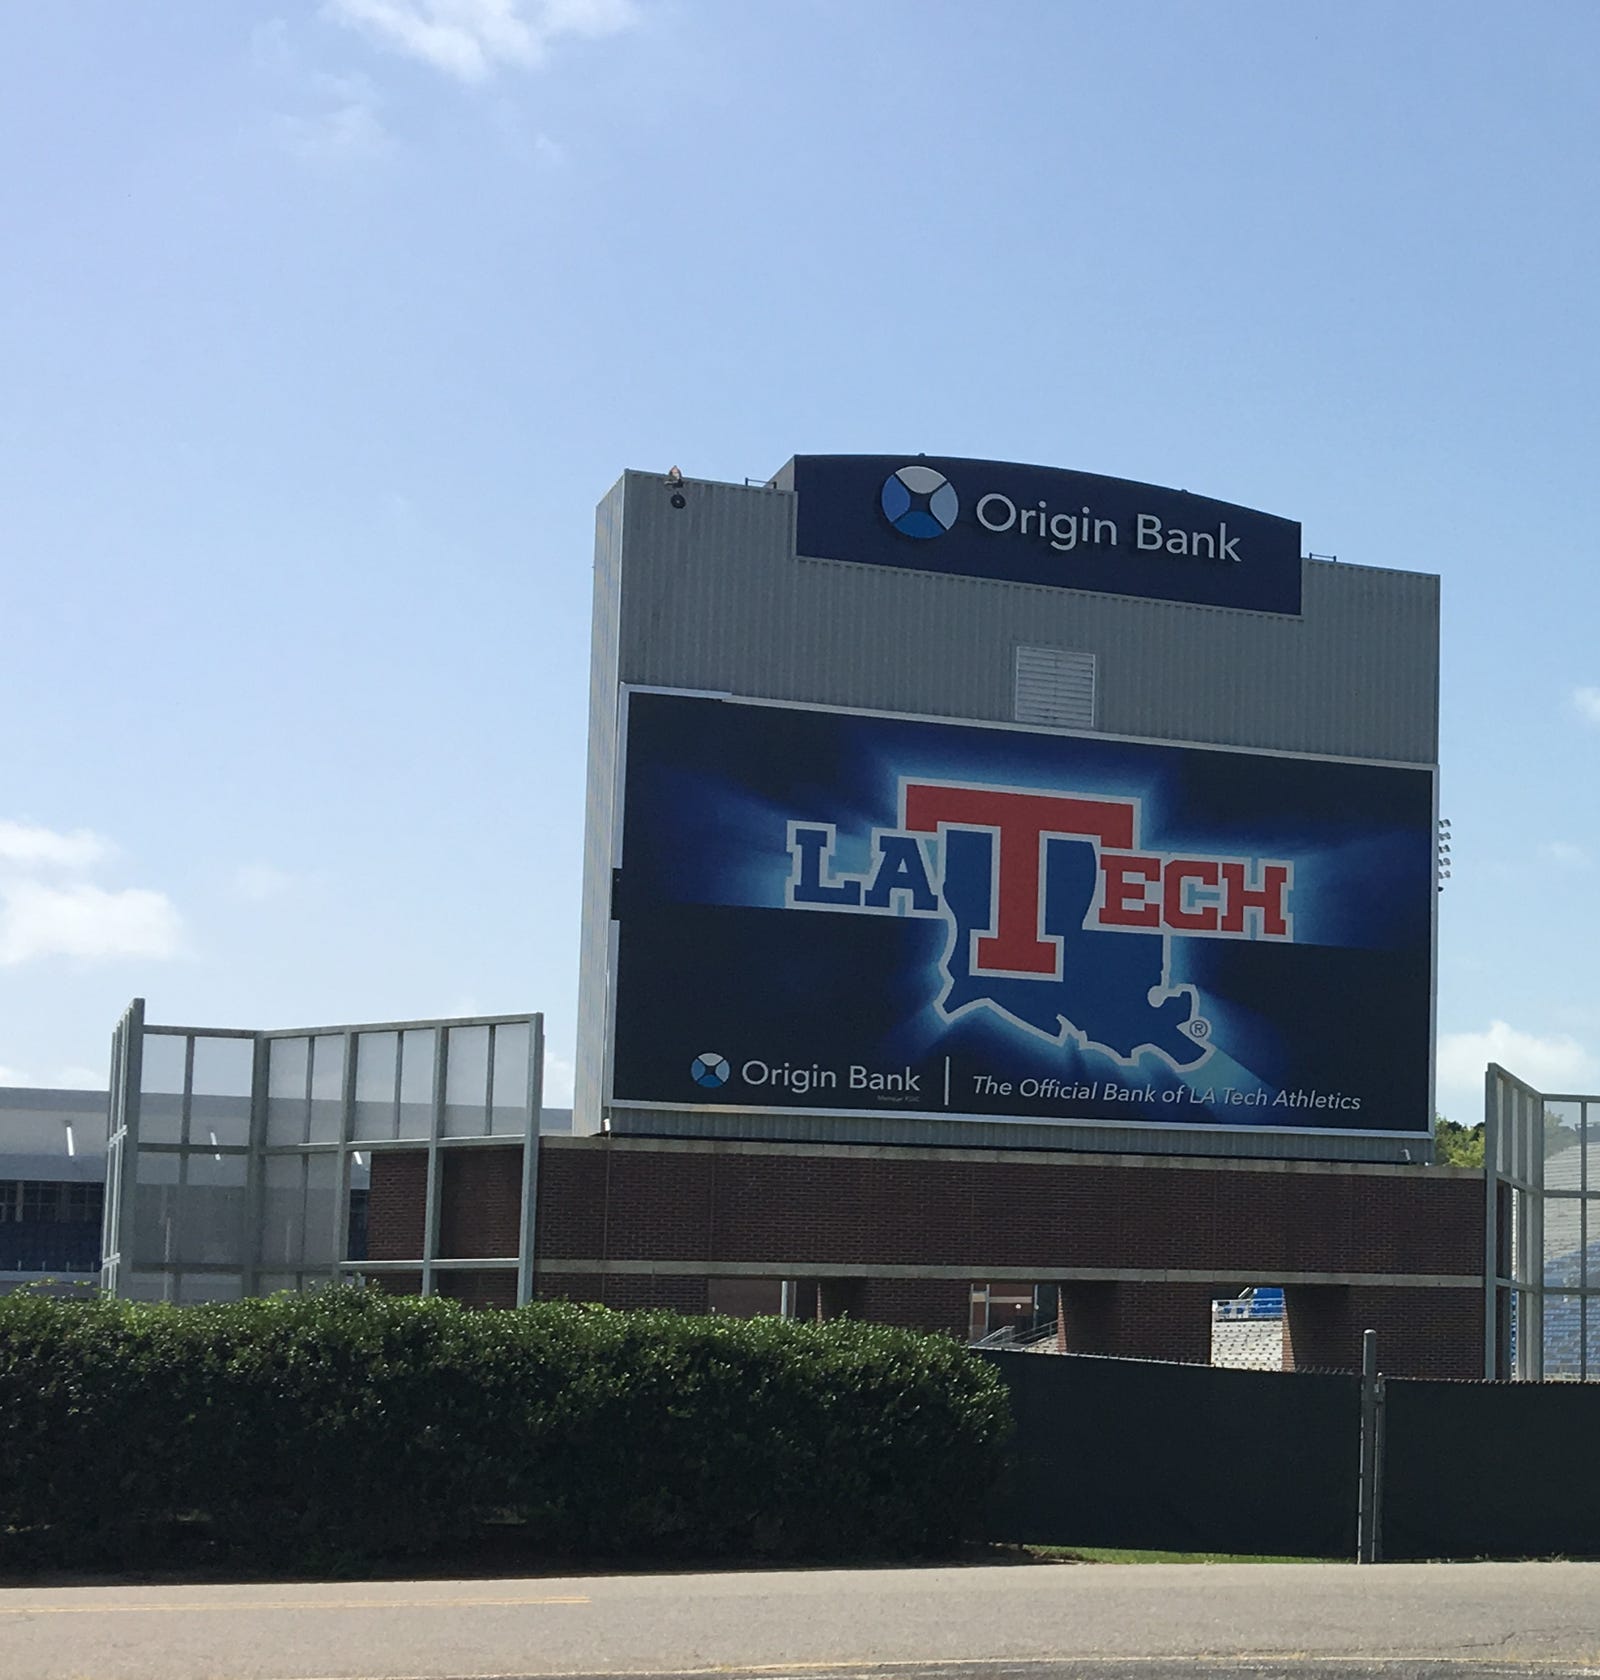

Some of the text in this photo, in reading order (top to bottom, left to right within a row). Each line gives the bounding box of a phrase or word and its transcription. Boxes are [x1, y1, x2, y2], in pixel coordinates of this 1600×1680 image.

[976, 493, 1242, 562] Origin Bank
[787, 777, 1294, 982] LA TECH
[742, 1060, 921, 1093] Origin Bank
[973, 1076, 1361, 1111] The Official Bank of LA Tech Athletics
